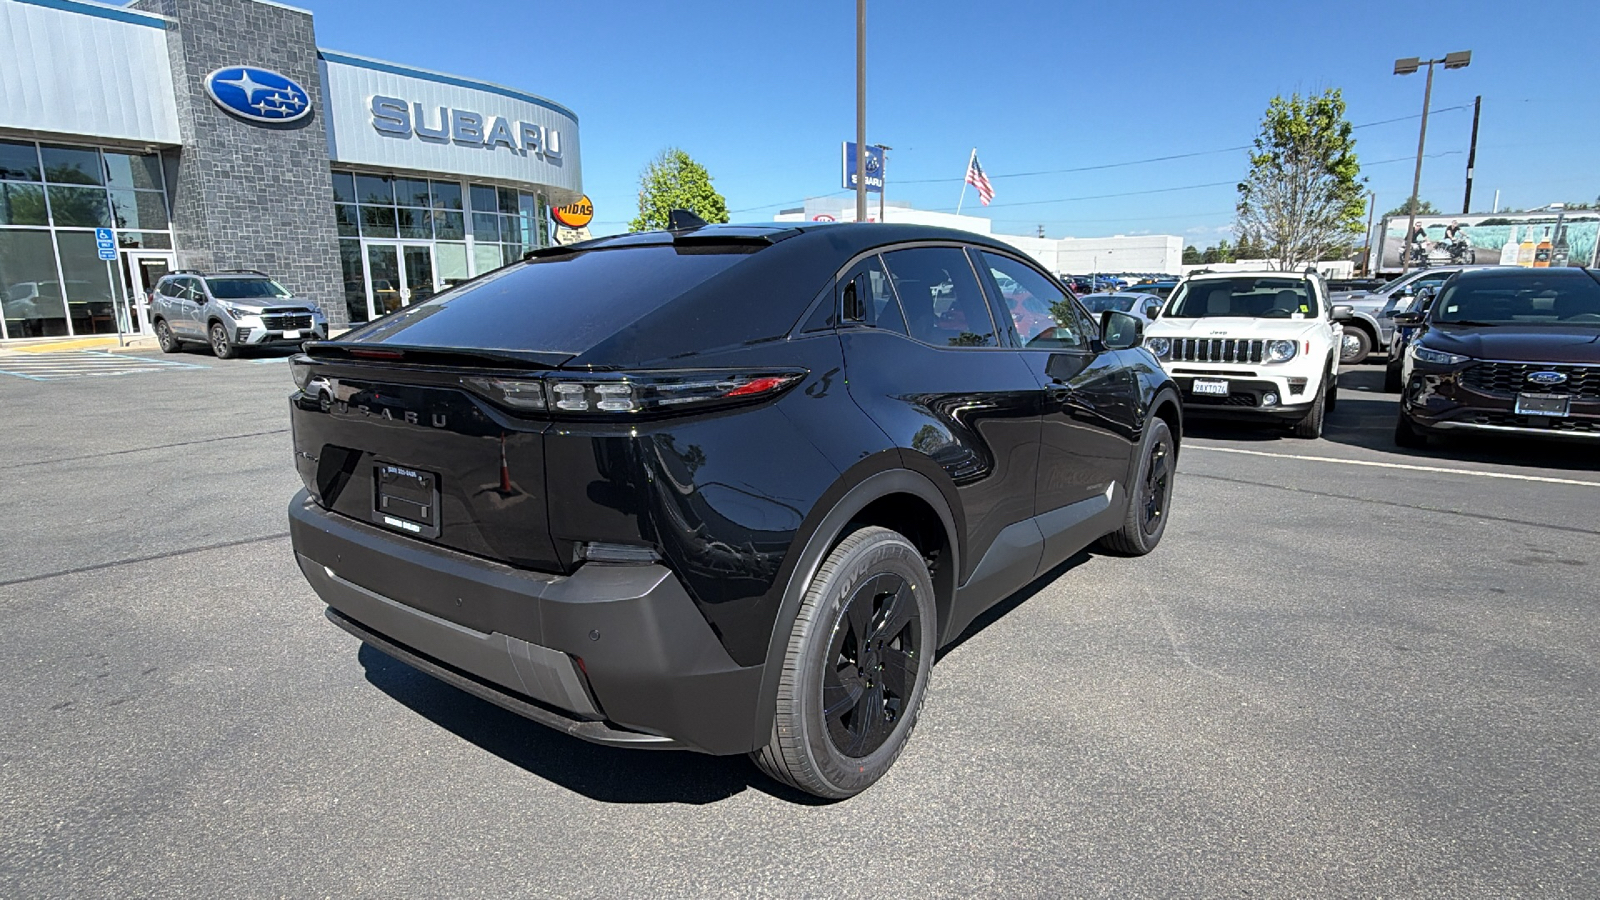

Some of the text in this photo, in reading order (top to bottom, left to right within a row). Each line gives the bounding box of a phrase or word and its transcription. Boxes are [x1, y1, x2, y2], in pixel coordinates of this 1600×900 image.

[370, 94, 564, 160] SUBARU
[851, 174, 883, 187] SBARU
[558, 204, 592, 216] MIDAS
